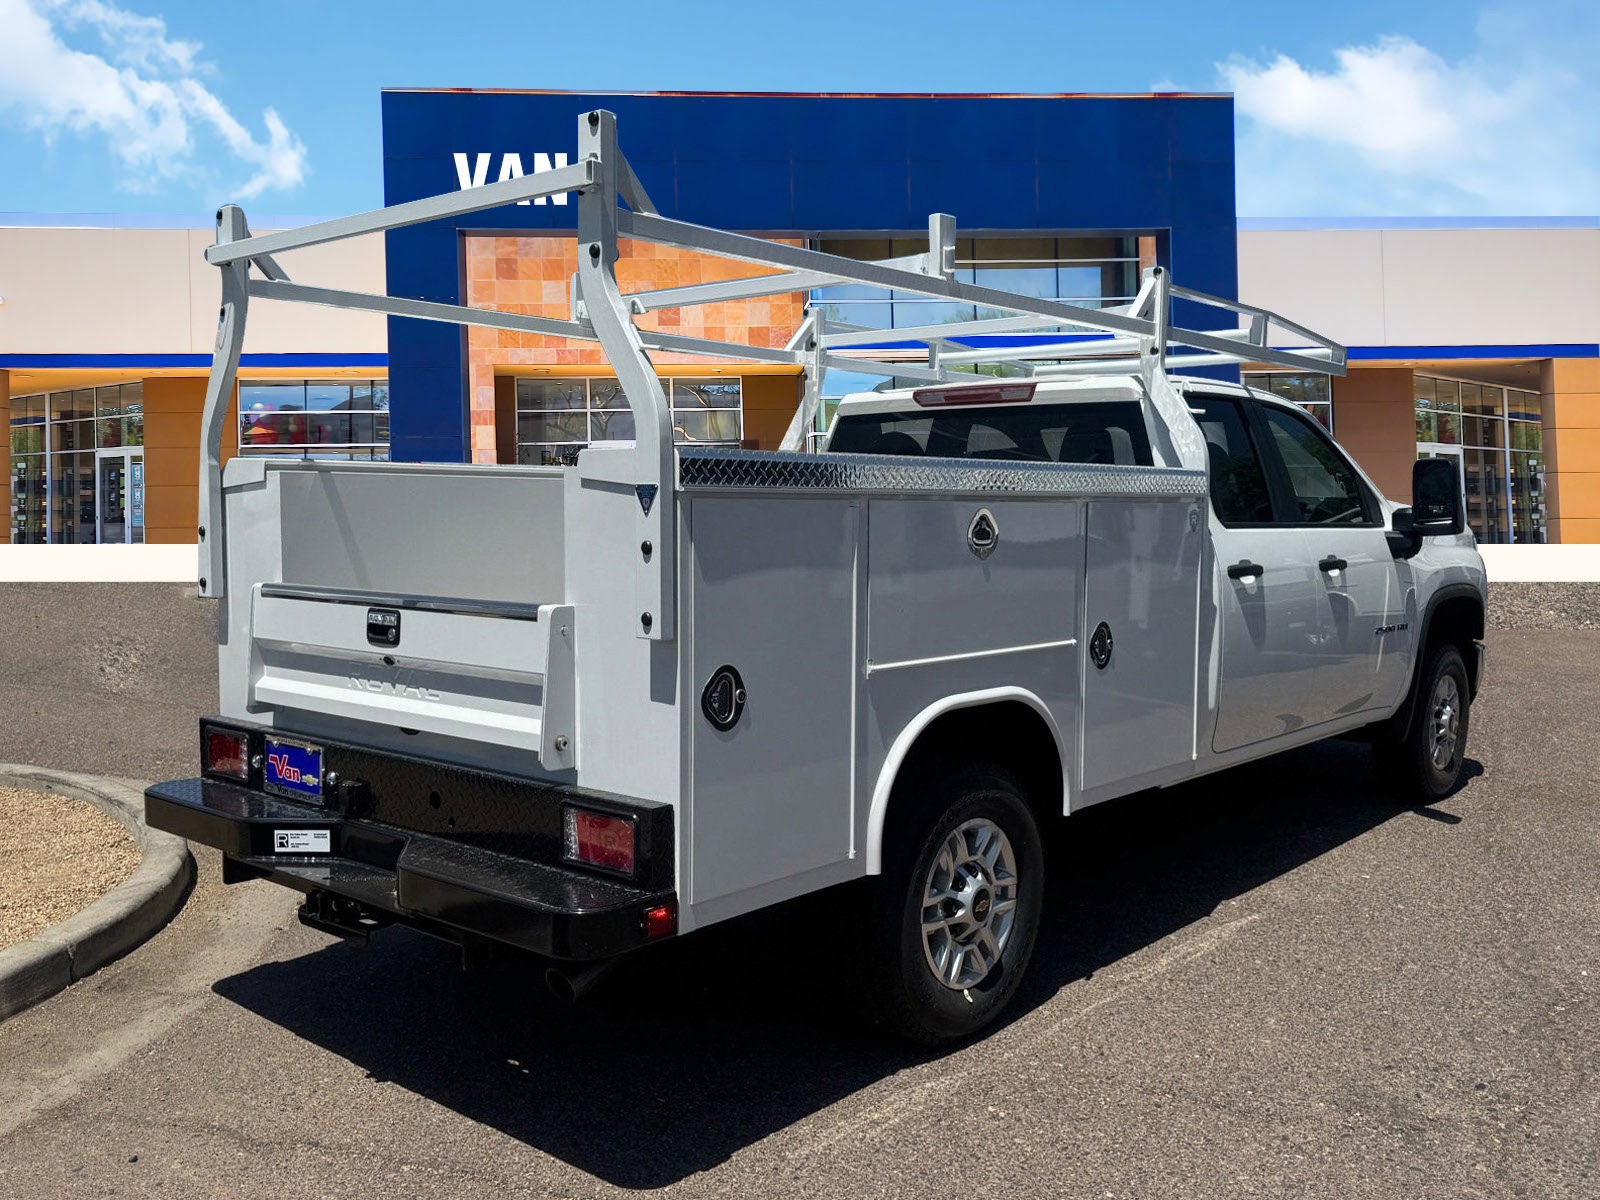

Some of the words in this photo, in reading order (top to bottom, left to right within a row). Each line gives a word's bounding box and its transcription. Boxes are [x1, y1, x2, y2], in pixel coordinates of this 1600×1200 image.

[453, 152, 568, 206] VAN
[269, 754, 301, 783] Van
[277, 833, 289, 848] R
